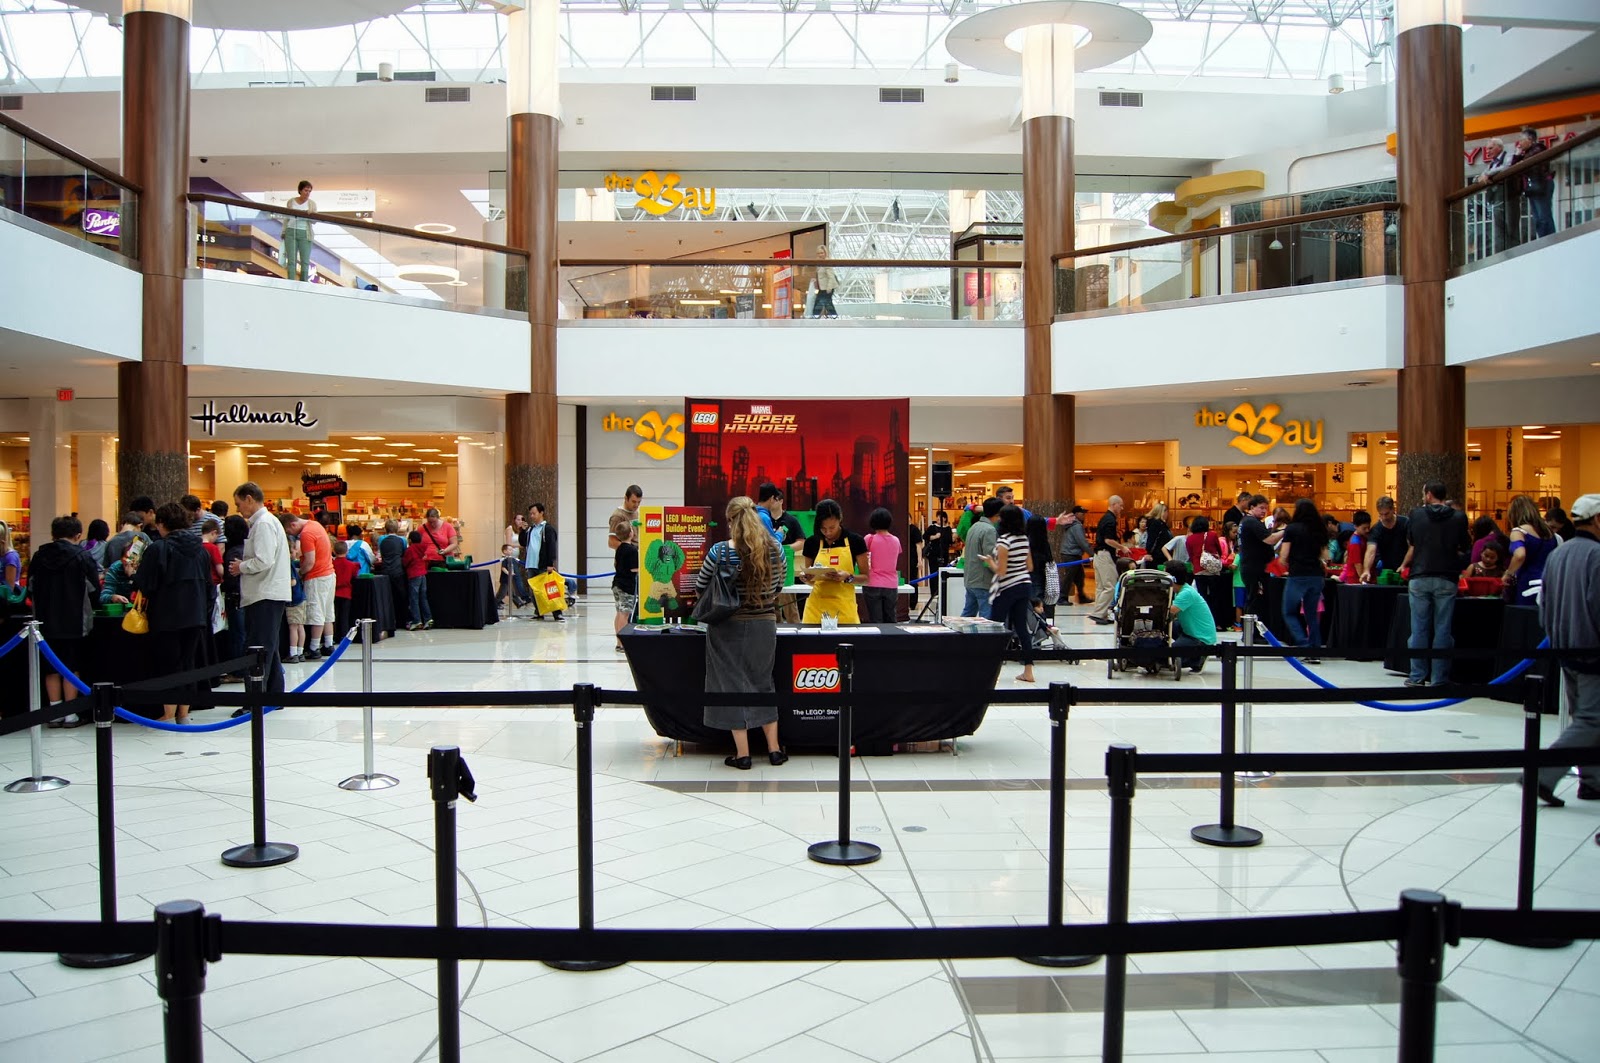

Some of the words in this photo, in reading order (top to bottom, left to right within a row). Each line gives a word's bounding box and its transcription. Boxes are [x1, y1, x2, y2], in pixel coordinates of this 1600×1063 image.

[604, 171, 633, 192] the
[633, 170, 716, 216] Bay
[59, 390, 72, 401] EXIT
[751, 405, 772, 414] MARVEL
[189, 400, 318, 436] Hallmark
[602, 411, 634, 432] the
[693, 412, 718, 425] LEGO
[733, 414, 796, 424] SUPER
[723, 424, 798, 434] HEROES
[1194, 406, 1227, 427] the
[1226, 402, 1324, 456] Bay
[646, 519, 661, 528] LEGO
[681, 514, 704, 523] Master
[665, 524, 687, 533] Builder
[688, 524, 706, 533] Event!
[795, 668, 839, 689] LEGO
